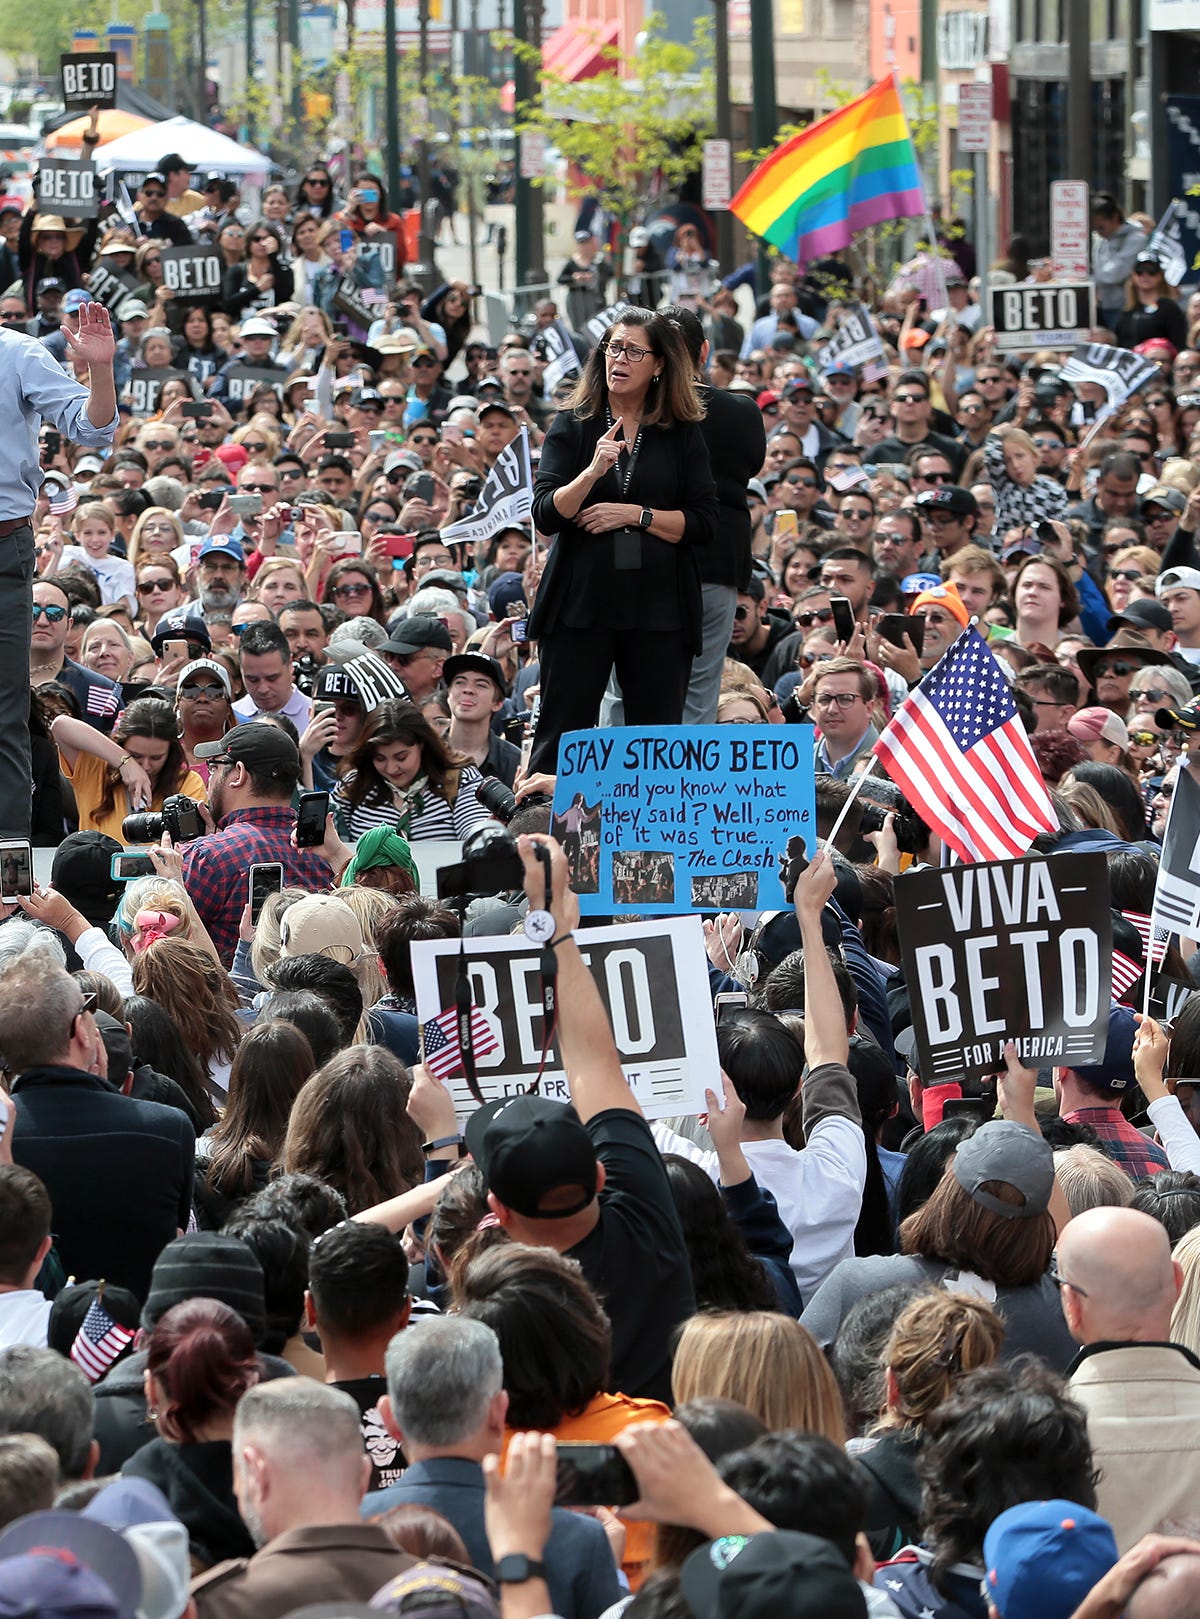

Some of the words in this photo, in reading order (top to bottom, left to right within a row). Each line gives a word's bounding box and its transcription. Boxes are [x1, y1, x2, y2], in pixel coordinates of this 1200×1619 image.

[63, 63, 115, 94] BETO
[40, 168, 95, 199] BETO
[164, 256, 221, 290] BETO
[1004, 288, 1077, 331] BETO
[343, 652, 405, 713] BETO
[562, 738, 615, 777] STAY
[623, 738, 720, 772] STRONG
[729, 740, 799, 772] BETO
[647, 785, 675, 806] you
[681, 777, 726, 801] know
[735, 778, 787, 798] what
[602, 801, 641, 829] they
[713, 802, 760, 827] Well,
[765, 807, 811, 825] some
[604, 826, 623, 847] of
[636, 826, 650, 844] it
[660, 828, 698, 845] was
[722, 849, 775, 869] Clash
[941, 861, 1062, 932] VIVA
[915, 927, 1098, 1046] BETO
[963, 1042, 993, 1068] FOR
